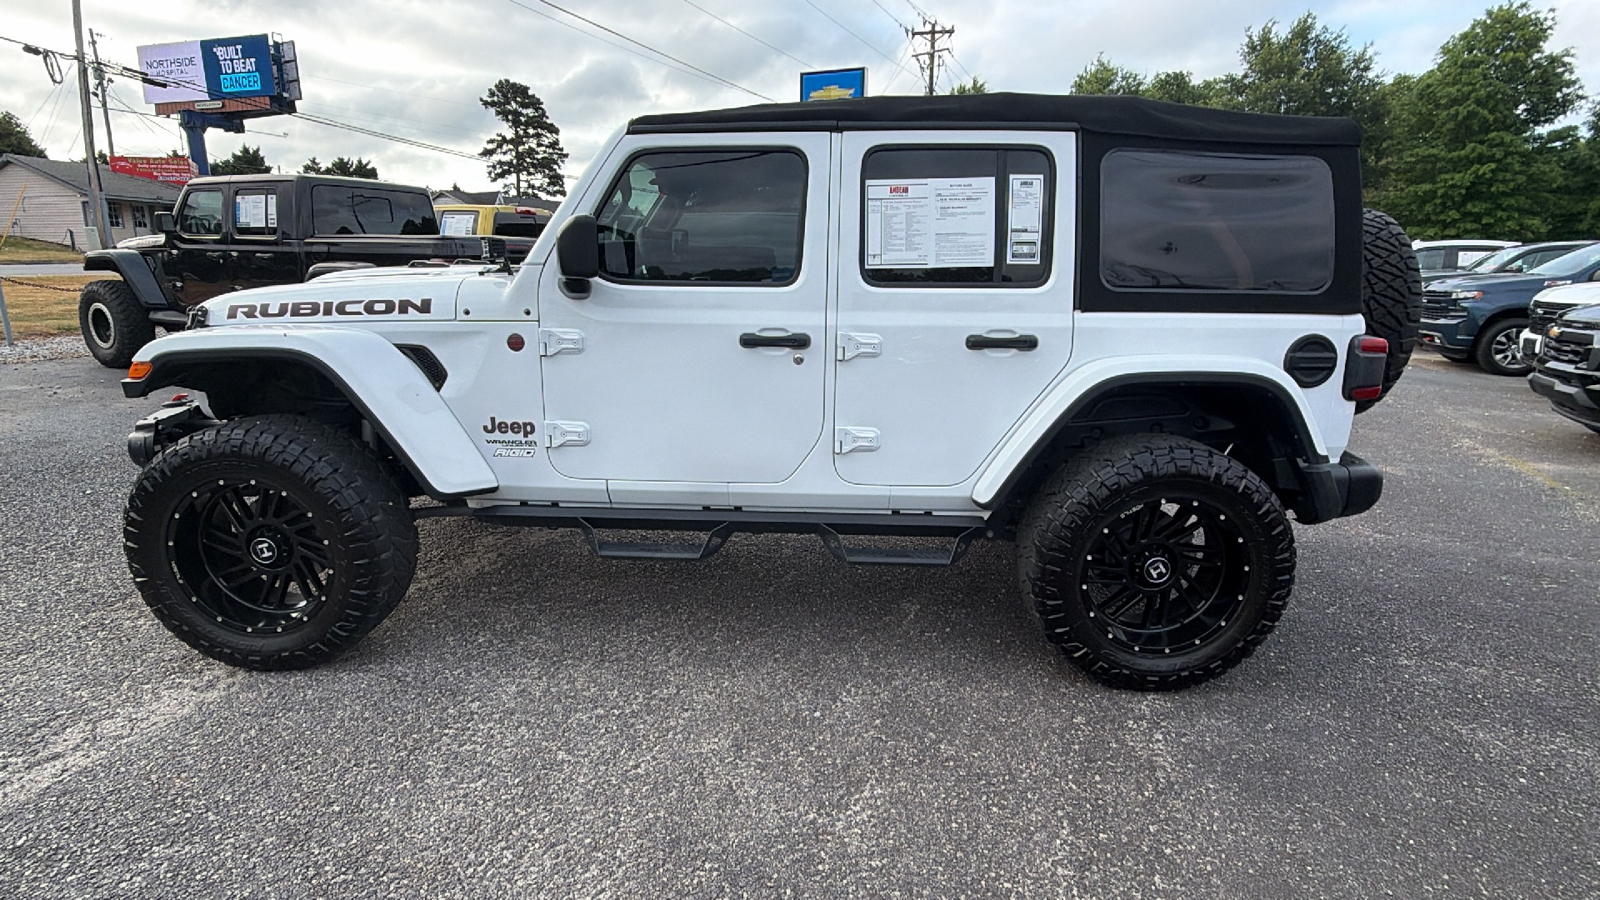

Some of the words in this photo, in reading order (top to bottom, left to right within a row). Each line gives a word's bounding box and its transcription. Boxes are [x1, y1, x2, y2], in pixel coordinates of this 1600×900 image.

[217, 44, 243, 60] BUILT
[145, 56, 197, 70] NORTHSIDE
[219, 60, 233, 74] TO
[233, 58, 256, 73] BEAT
[156, 68, 189, 76] HOSPITAL
[222, 75, 260, 89] CANCER
[226, 298, 432, 320] RUBICON
[482, 416, 536, 438] Jeep
[493, 448, 536, 457] RIGID
